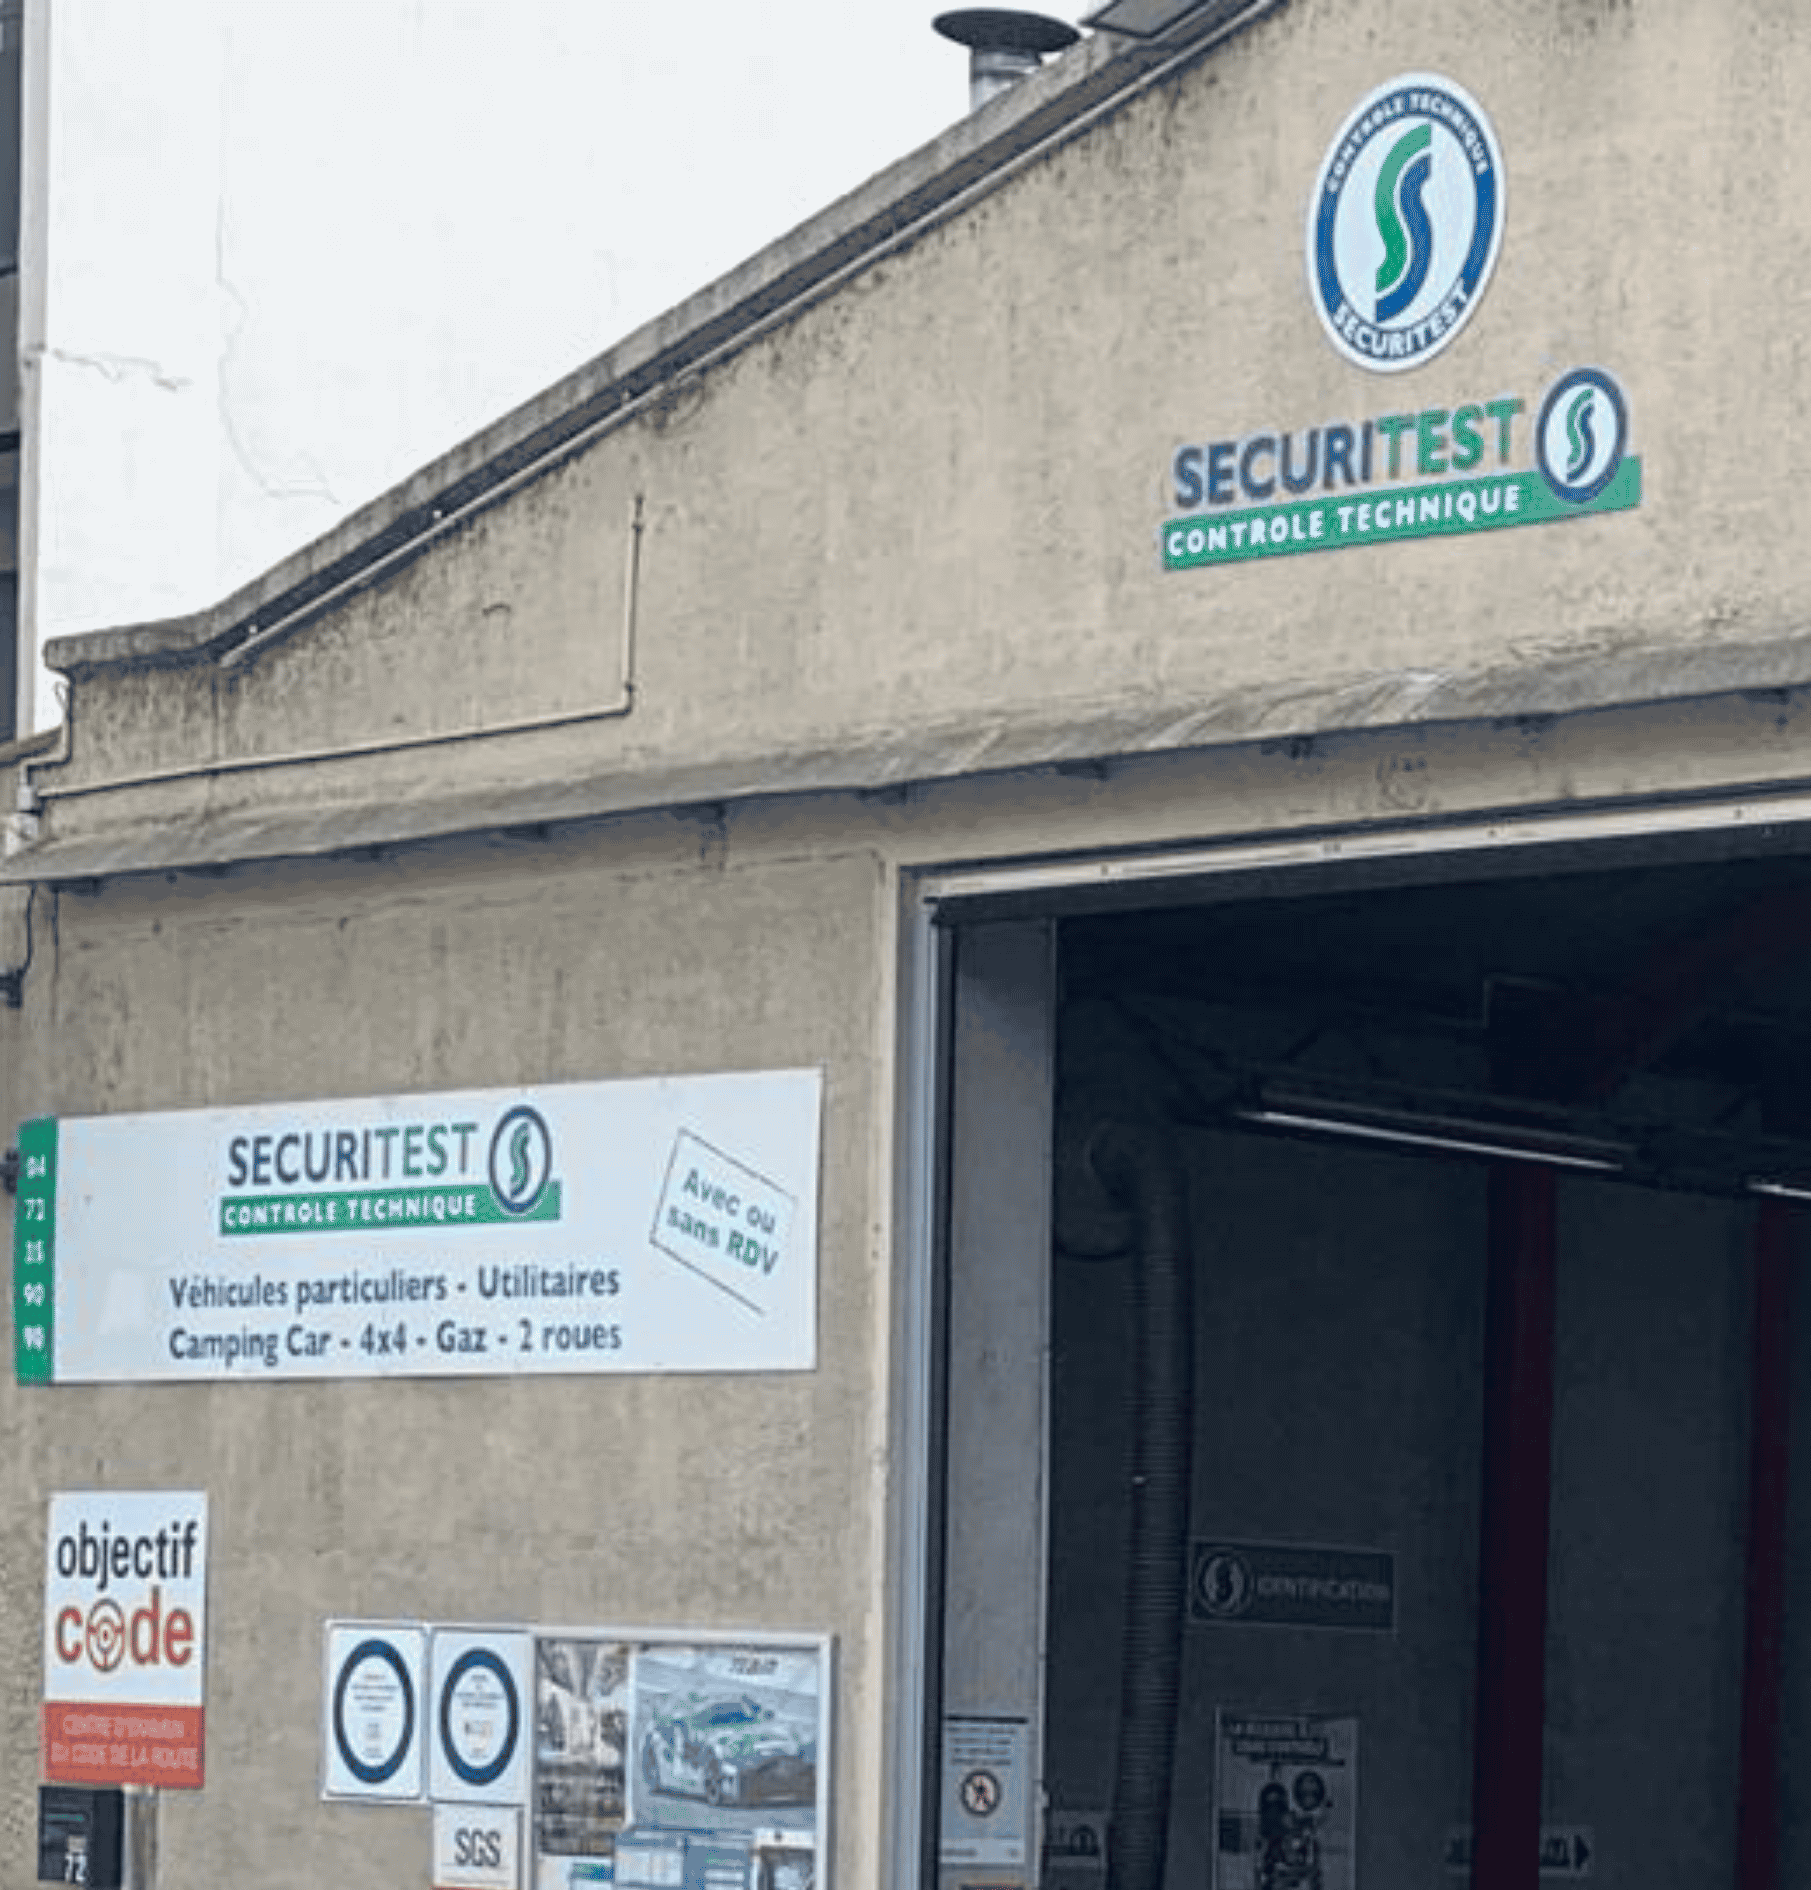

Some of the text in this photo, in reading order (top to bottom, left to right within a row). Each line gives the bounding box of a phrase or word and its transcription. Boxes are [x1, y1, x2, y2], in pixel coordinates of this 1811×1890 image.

[1326, 92, 1489, 194] CONTROLE TECHNIQUE
[1333, 277, 1471, 356] SECURITEST
[1173, 399, 1525, 507] SECURITEST
[1169, 485, 1520, 557] CONTROLE TECHNIQUE
[228, 1122, 478, 1187] SECURITEST
[224, 1194, 476, 1227] CONTROLE TECHNIQUE
[682, 1168, 776, 1234] Avec ou
[667, 1205, 779, 1276] sans RDV
[169, 1272, 288, 1309] Véhicules
[299, 1268, 449, 1314] particuliers
[477, 1262, 620, 1299] Utilitaires
[169, 1326, 279, 1369] Camping
[287, 1325, 332, 1357] Car
[359, 1321, 407, 1354] 4x4
[436, 1320, 488, 1352] Gaz
[518, 1318, 532, 1351] 2
[542, 1322, 622, 1351] roues
[57, 1518, 198, 1592] objectif
[56, 1585, 194, 1673] code
[454, 1828, 501, 1867] SGS
